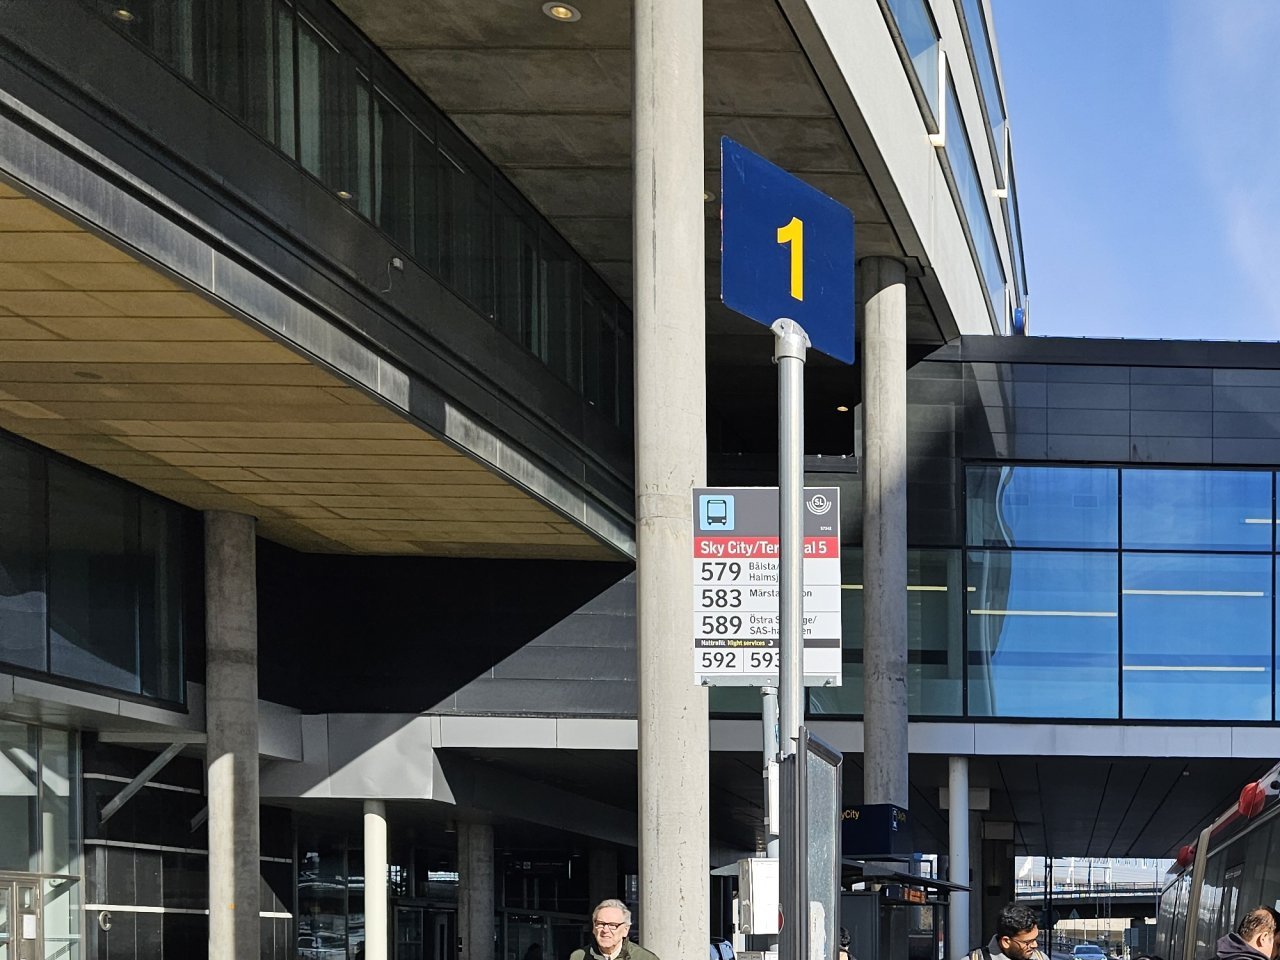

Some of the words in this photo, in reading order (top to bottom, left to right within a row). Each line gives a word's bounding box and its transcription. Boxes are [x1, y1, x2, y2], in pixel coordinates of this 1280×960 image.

[777, 216, 804, 302] 1
[701, 540, 725, 557] Sky
[728, 540, 816, 557] City/Teral
[819, 540, 827, 554] 5
[701, 562, 742, 581] 579
[749, 573, 779, 582] Halmsj
[702, 589, 742, 608] 583
[749, 588, 779, 598] Märsta
[702, 615, 742, 635] 589
[749, 613, 773, 624] Östra
[702, 651, 737, 668] 592
